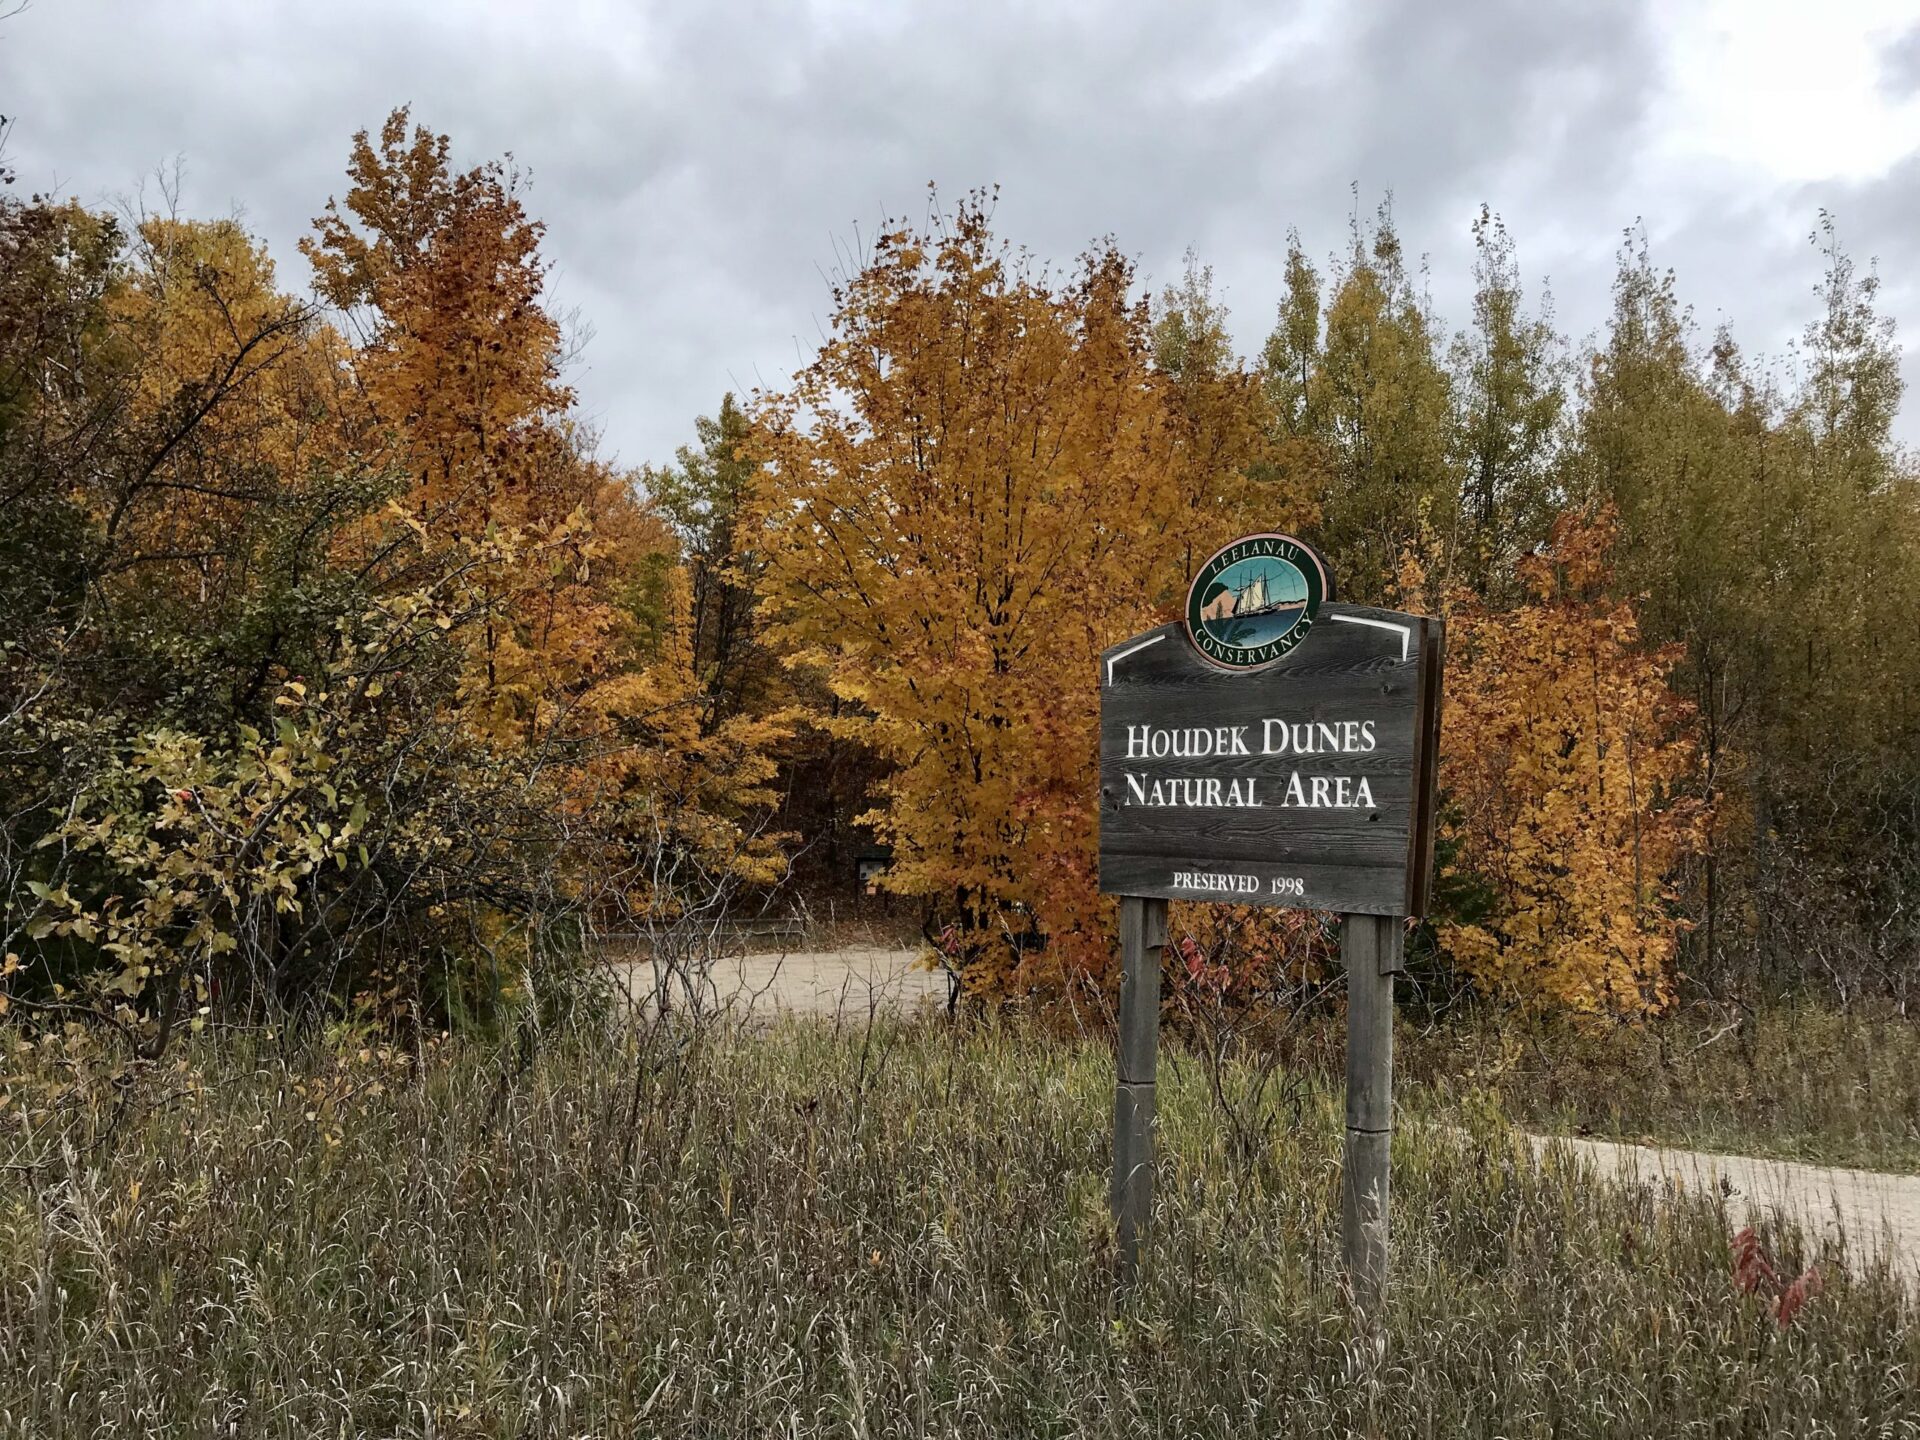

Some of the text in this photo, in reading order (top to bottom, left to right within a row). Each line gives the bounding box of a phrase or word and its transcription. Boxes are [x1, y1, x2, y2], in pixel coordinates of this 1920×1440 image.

[1211, 541, 1300, 574] LEELANAU
[1195, 612, 1314, 663] CONSERVANCY
[1126, 718, 1376, 759] HOUDEK DUNES
[1124, 770, 1377, 809] NATURAL AREA
[1172, 871, 1305, 896] PRESERVED 1998
